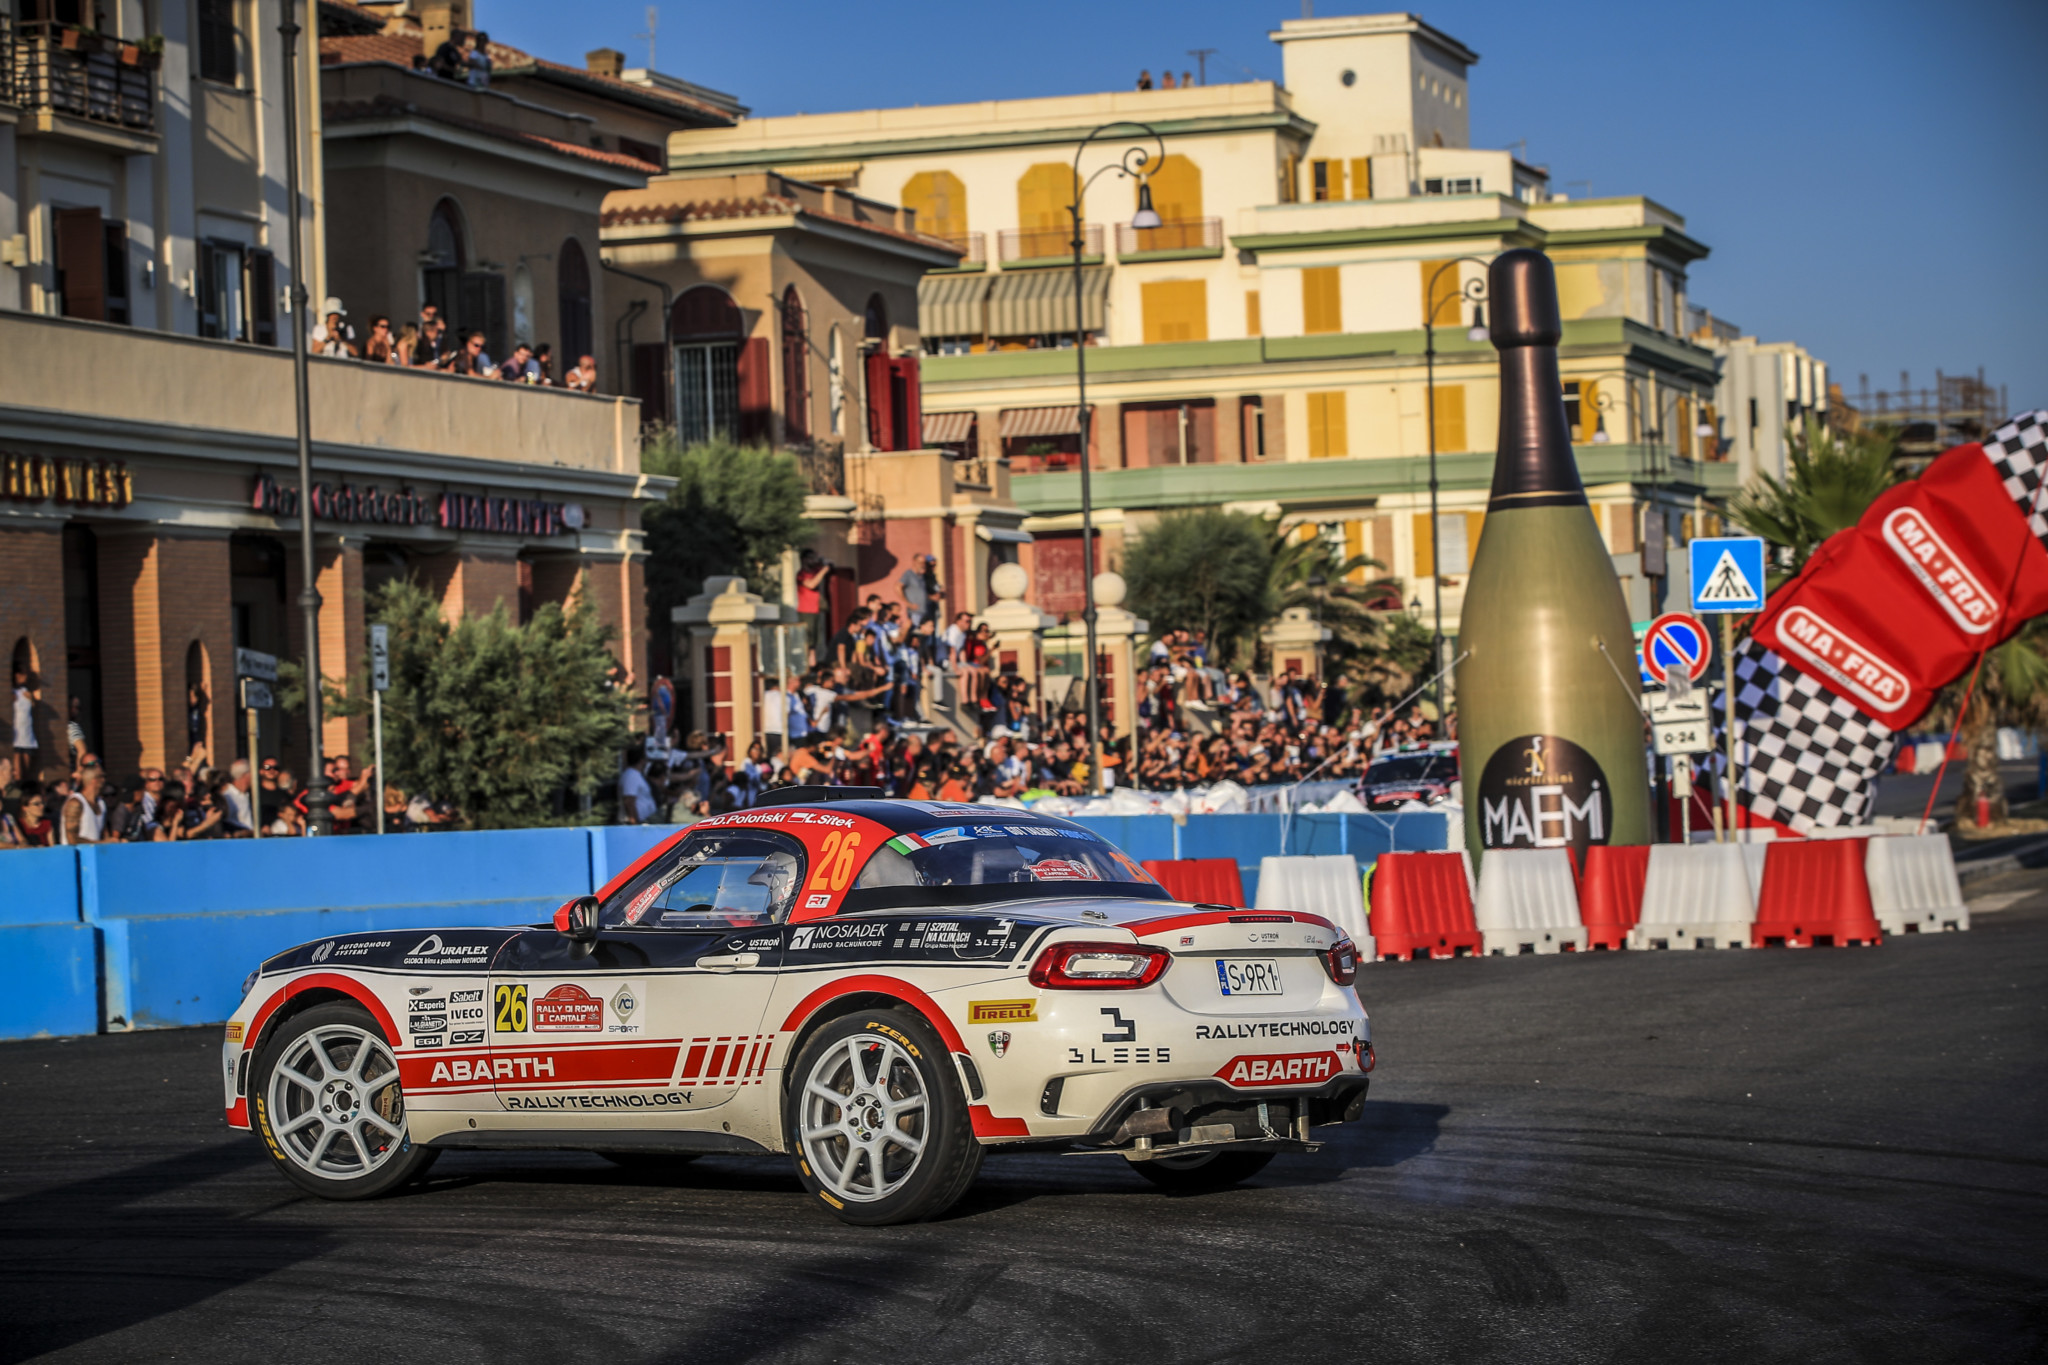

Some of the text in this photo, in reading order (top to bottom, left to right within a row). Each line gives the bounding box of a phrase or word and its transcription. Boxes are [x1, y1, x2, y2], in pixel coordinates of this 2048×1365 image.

[808, 830, 861, 892] 26
[814, 923, 888, 939] NOSIADEK
[930, 923, 959, 932] SZPITAL
[926, 932, 938, 942] NA
[338, 941, 391, 950] AUTONOMOUS
[812, 941, 833, 949] BIURO
[334, 948, 369, 956] SYSTEMS
[452, 990, 481, 1003] Sabelt
[419, 1000, 445, 1011] Experis
[495, 985, 527, 1032] 26
[536, 1005, 600, 1013] RALLY DI ROMA
[973, 1003, 1031, 1020] PIRELLI
[451, 1008, 483, 1020] IVECO
[549, 1014, 586, 1022] CAPITALE
[609, 1025, 639, 1033] SPORT
[1196, 1021, 1354, 1040] RALLYTECHNOLOGY
[430, 1056, 556, 1082] ABARTH
[1228, 1056, 1331, 1082] ABARTH
[508, 1091, 693, 1109] RALLYTECHNOLOGY
